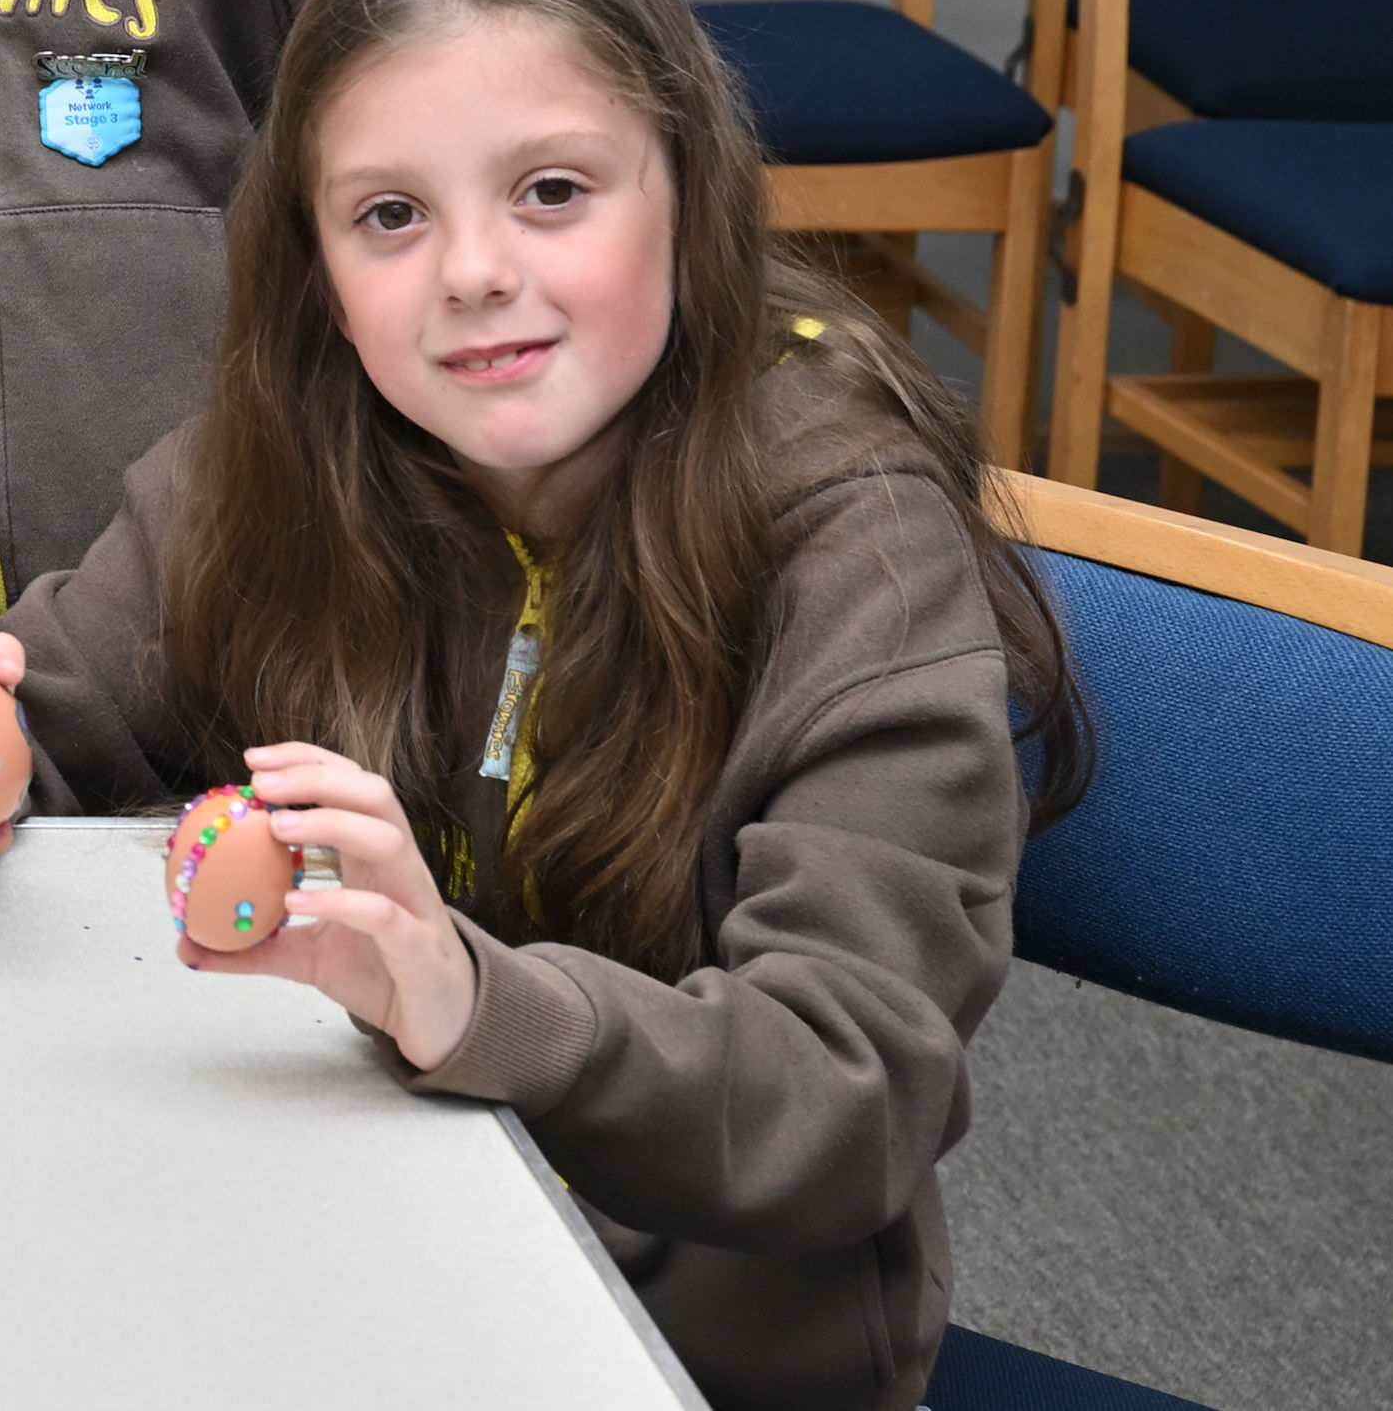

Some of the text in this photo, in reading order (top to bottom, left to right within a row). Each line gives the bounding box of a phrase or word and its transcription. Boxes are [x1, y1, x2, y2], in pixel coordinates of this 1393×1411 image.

[68, 101, 113, 112] Network
[64, 113, 119, 128] Stage 3
